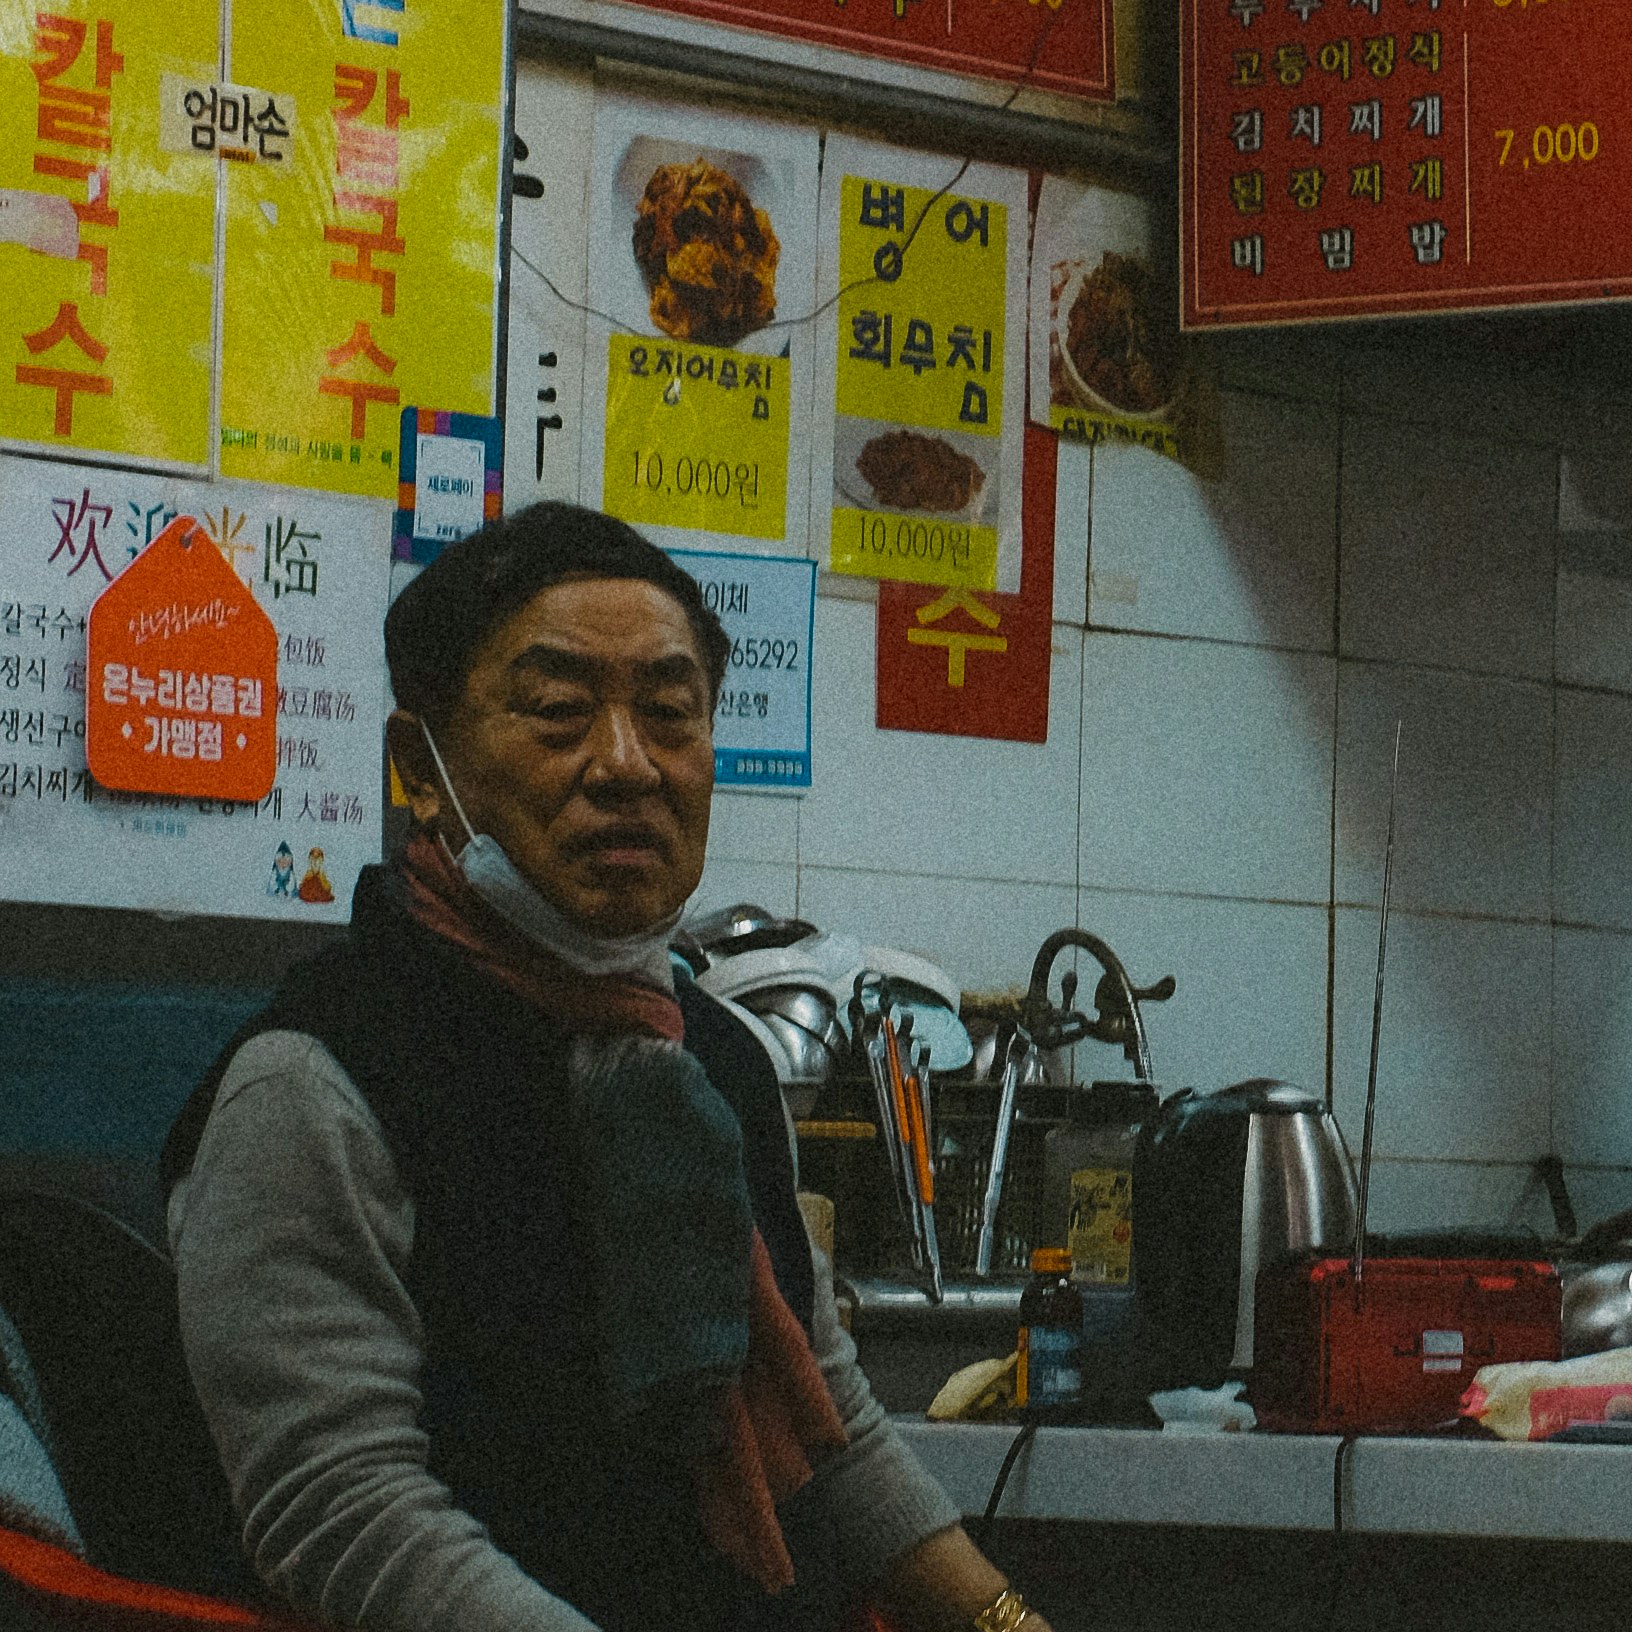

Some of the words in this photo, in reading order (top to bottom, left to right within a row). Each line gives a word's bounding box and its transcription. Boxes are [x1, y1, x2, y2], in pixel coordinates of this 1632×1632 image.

[1229, 30, 1442, 87] 고등어정식
[184, 85, 290, 161] 엄마손
[1230, 94, 1442, 154] 김치찌개
[1494, 122, 1600, 169] 7,000
[1228, 158, 1444, 216] 된장찌개
[860, 182, 991, 282] 병어
[1229, 221, 1445, 276] 비빔밥
[628, 347, 773, 420] 오징어무침
[849, 309, 994, 424] 회무침
[631, 449, 761, 511] 10,000원
[857, 515, 972, 568] 10,000원
[698, 581, 750, 614] 이체
[277, 633, 326, 669] 包饭
[729, 636, 799, 670] 65292
[102, 662, 262, 718] 온누리상품권
[144, 718, 223, 761] 가맹점
